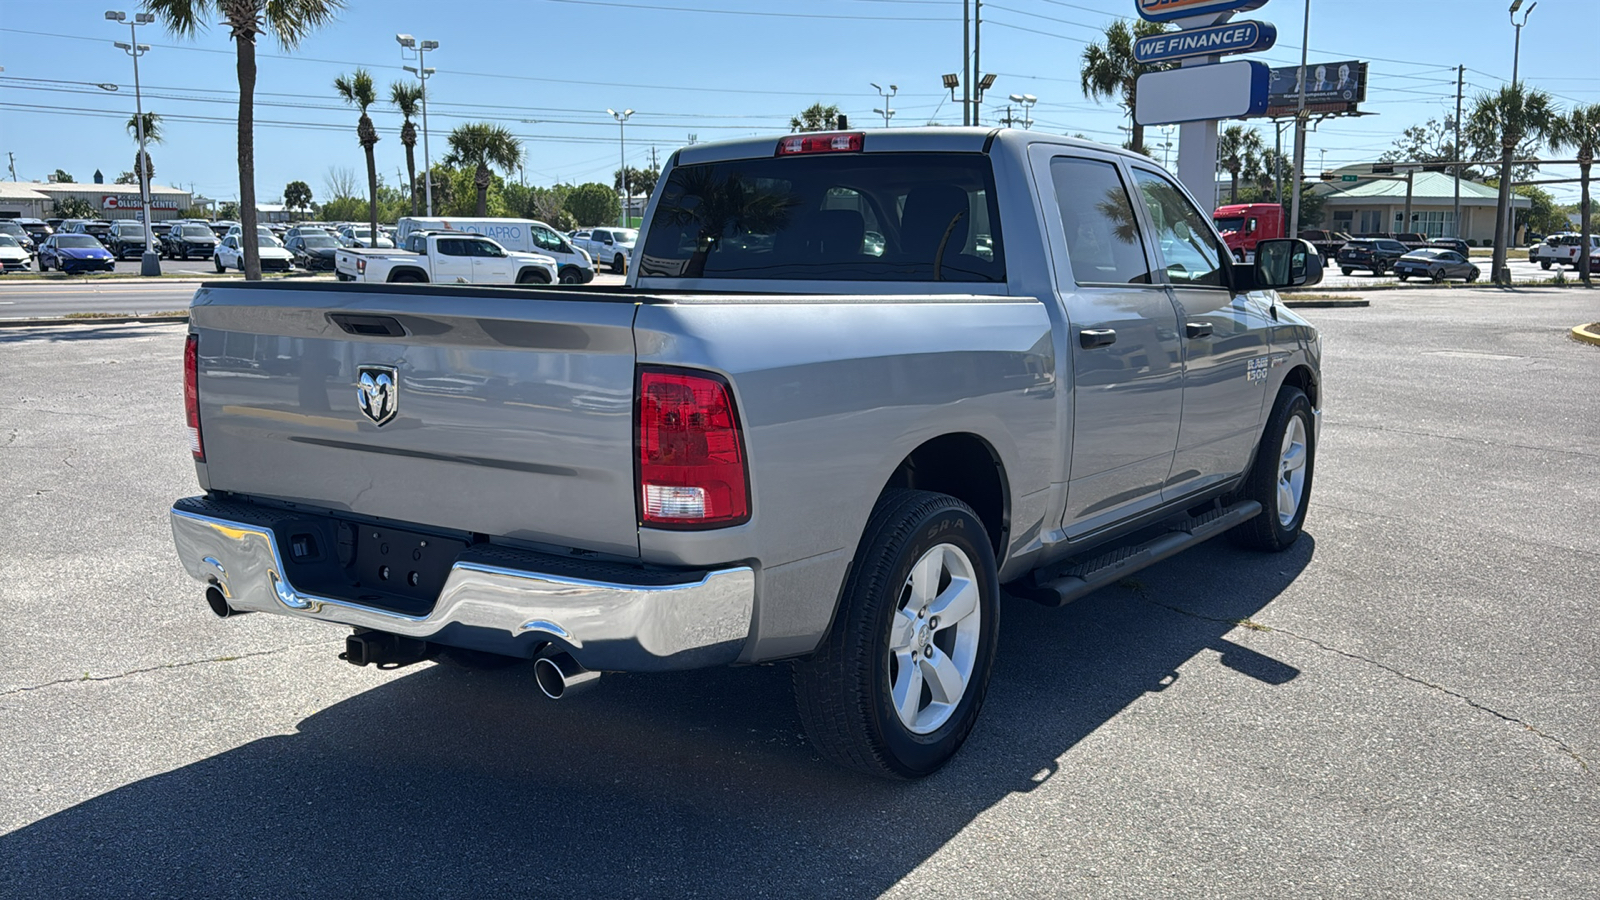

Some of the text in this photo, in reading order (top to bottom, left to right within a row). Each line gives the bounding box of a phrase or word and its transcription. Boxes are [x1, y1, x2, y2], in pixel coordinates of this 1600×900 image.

[1140, 28, 1251, 56] WE FINANCE!
[1247, 368, 1268, 381] 1500
